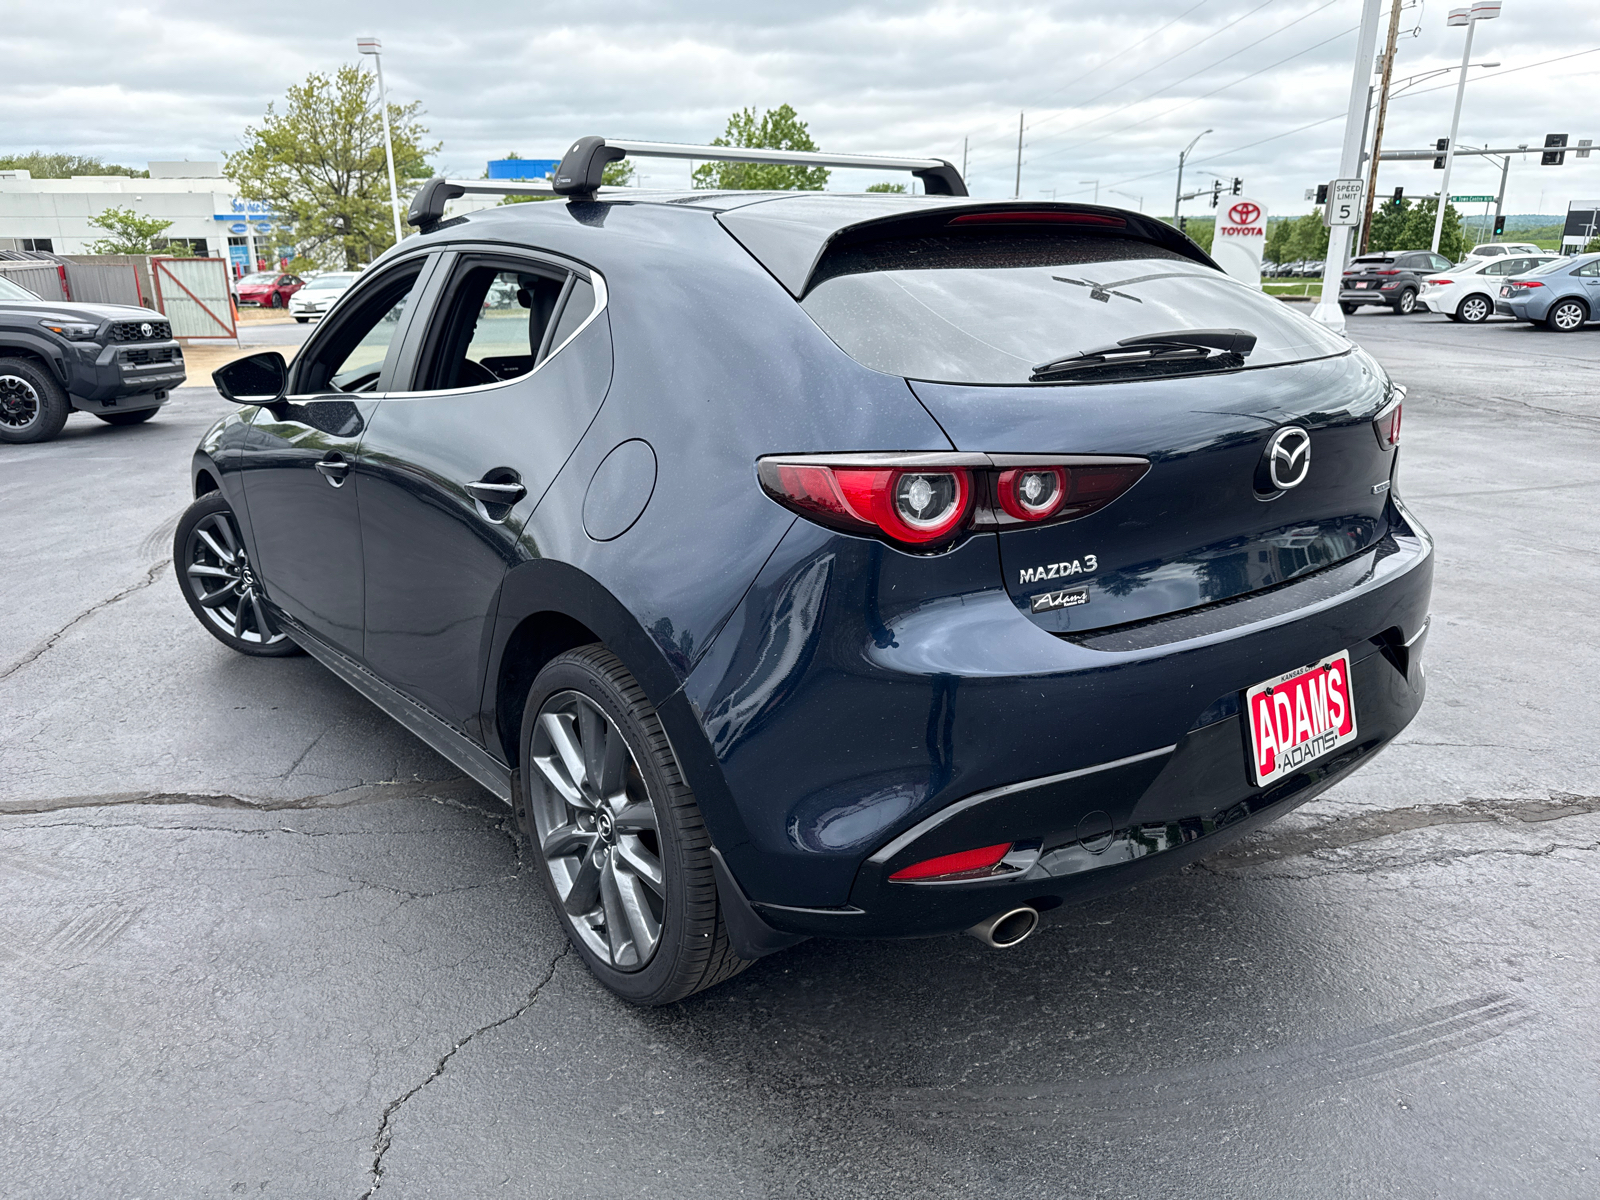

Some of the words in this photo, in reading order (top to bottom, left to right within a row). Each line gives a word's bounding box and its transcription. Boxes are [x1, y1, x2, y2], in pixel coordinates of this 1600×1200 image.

[1339, 205, 1351, 219] 5
[1220, 226, 1263, 236] TOYOTA
[1034, 592, 1088, 607] Adams
[1281, 668, 1304, 682] KANSAS
[1259, 668, 1345, 767] ADAMS
[1282, 731, 1336, 772] ADAMS
